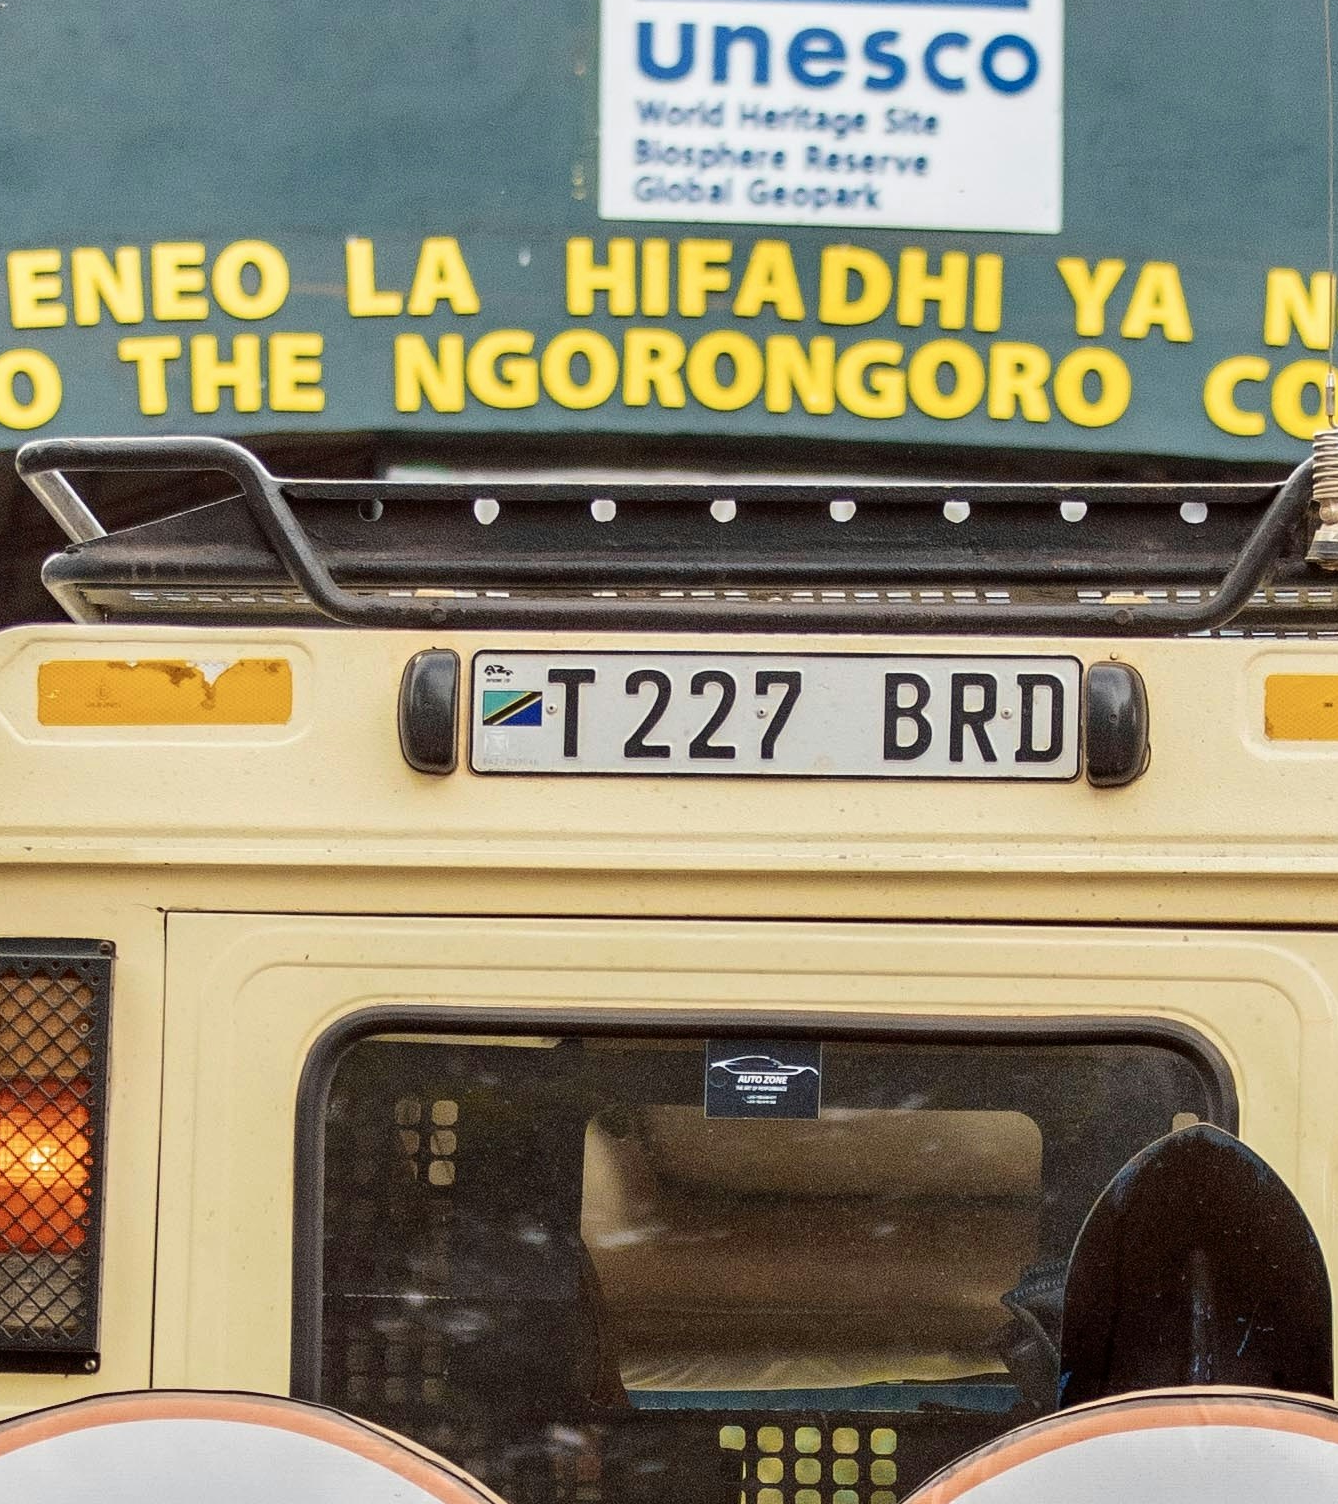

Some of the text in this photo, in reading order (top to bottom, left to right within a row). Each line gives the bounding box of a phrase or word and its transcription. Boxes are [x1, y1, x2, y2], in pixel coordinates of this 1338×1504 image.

[636, 21, 1039, 95] unesco
[636, 99, 940, 139] World Heritage Site
[635, 139, 930, 176] Biosphere Reserve
[633, 176, 881, 212] Global Geopark
[7, 239, 289, 329] ENEO
[346, 235, 480, 317] LA
[565, 236, 1003, 333] HIFADHI
[1057, 257, 1193, 343] YA
[118, 332, 325, 416] THE
[394, 327, 1131, 428] NGORONGORO
[548, 668, 1065, 763] T 227 BRD
[737, 1075, 788, 1085] AUTO ZONE
